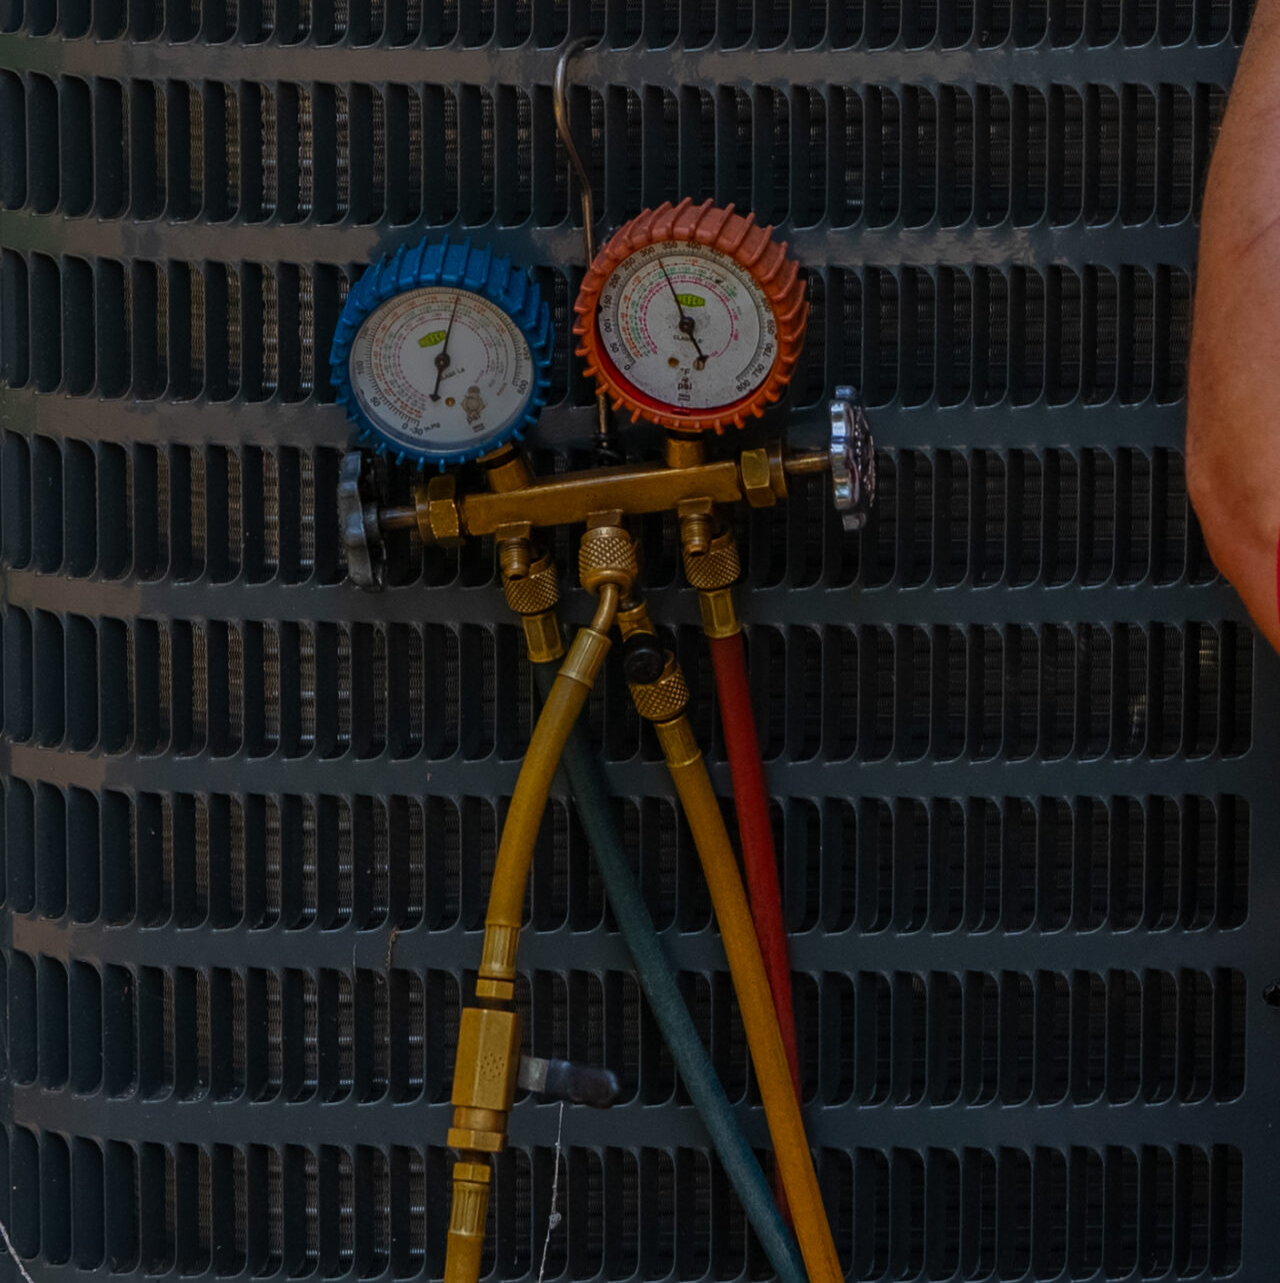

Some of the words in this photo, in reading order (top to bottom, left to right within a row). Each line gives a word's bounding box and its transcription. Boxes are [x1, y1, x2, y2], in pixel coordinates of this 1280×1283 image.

[662, 241, 677, 249] 350
[686, 239, 701, 249] 400
[640, 246, 655, 257] 300
[622, 257, 635, 270] 250
[609, 274, 621, 288] 200
[605, 295, 613, 309] 150
[609, 342, 619, 353] 50
[763, 343, 773, 357] 700
[752, 364, 764, 377] 750
[678, 382, 692, 391] psi
[736, 380, 750, 391] 800
[356, 360, 364, 374] 100
[370, 397, 381, 407] 50
[409, 426, 423, 435] -30
